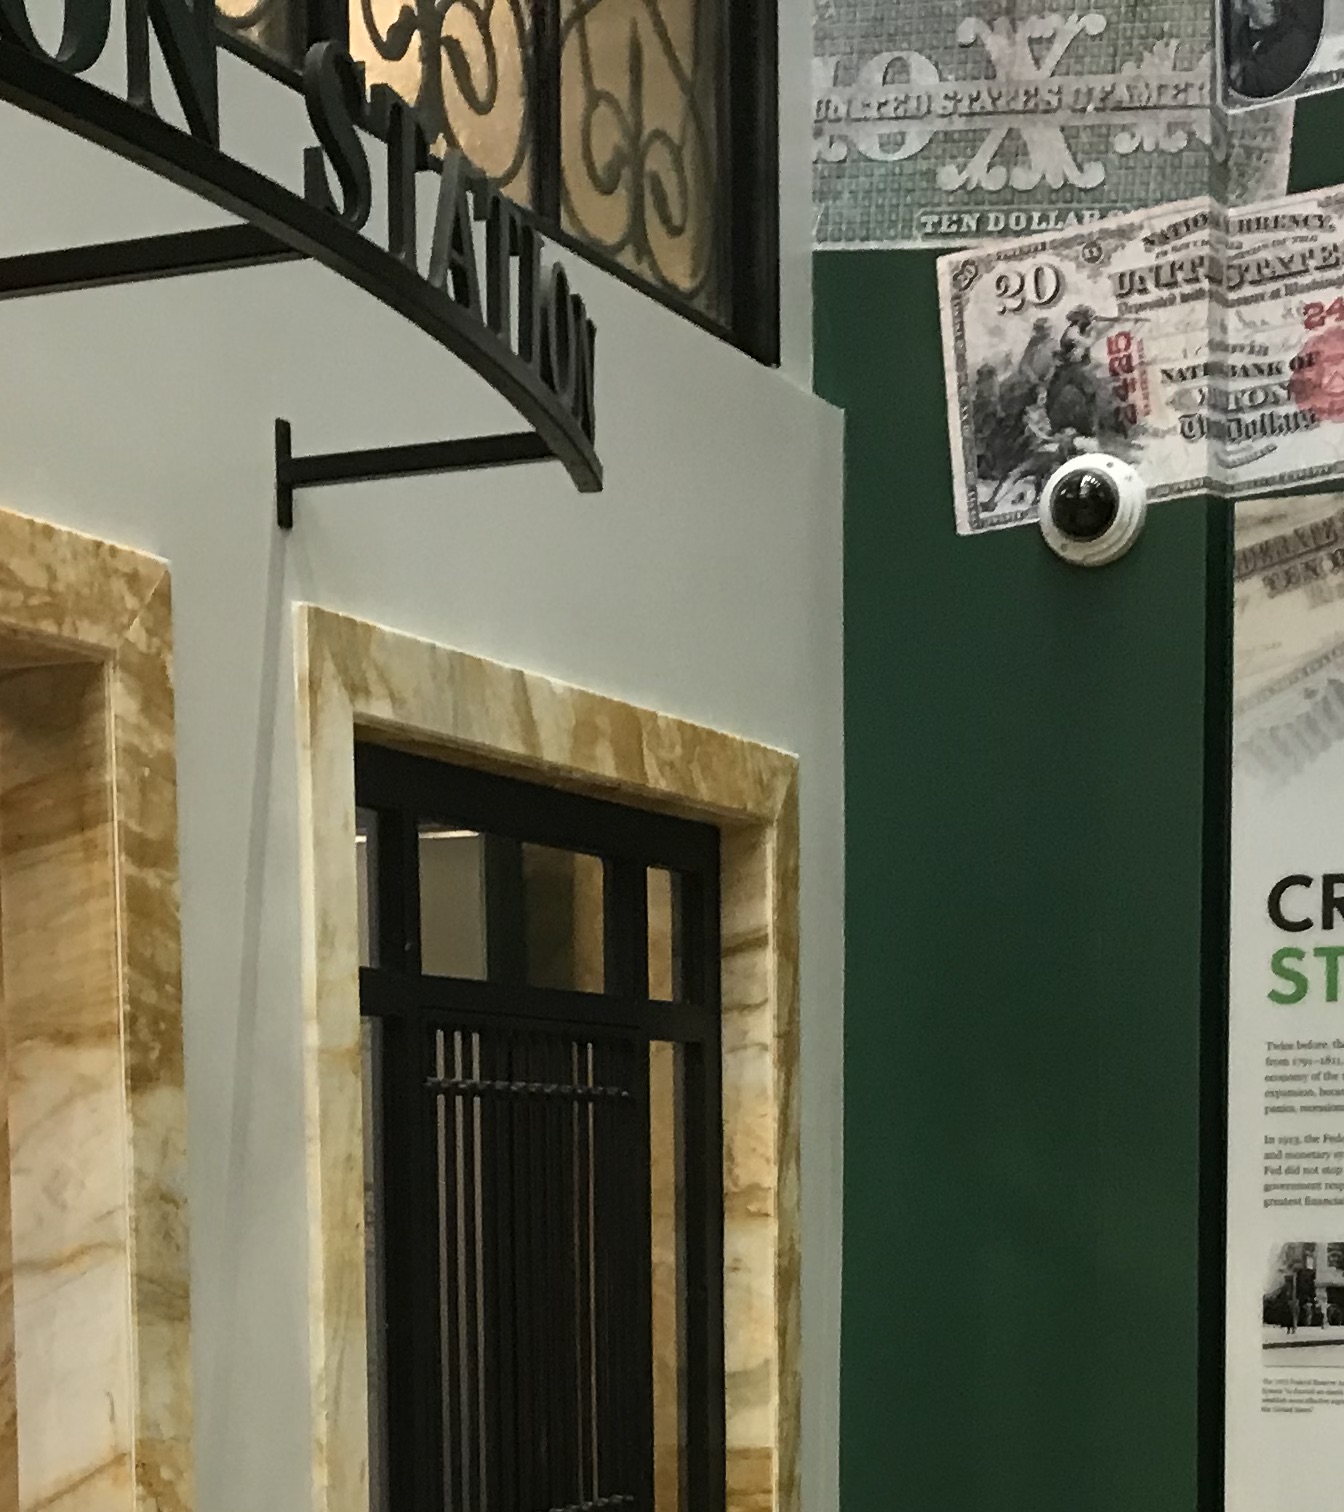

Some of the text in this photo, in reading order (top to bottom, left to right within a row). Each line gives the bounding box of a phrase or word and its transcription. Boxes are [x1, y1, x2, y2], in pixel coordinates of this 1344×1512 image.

[302, 40, 597, 443] STATION
[920, 212, 979, 235] TEN
[986, 208, 1128, 232] DOLLAR
[995, 262, 1063, 316] 20
